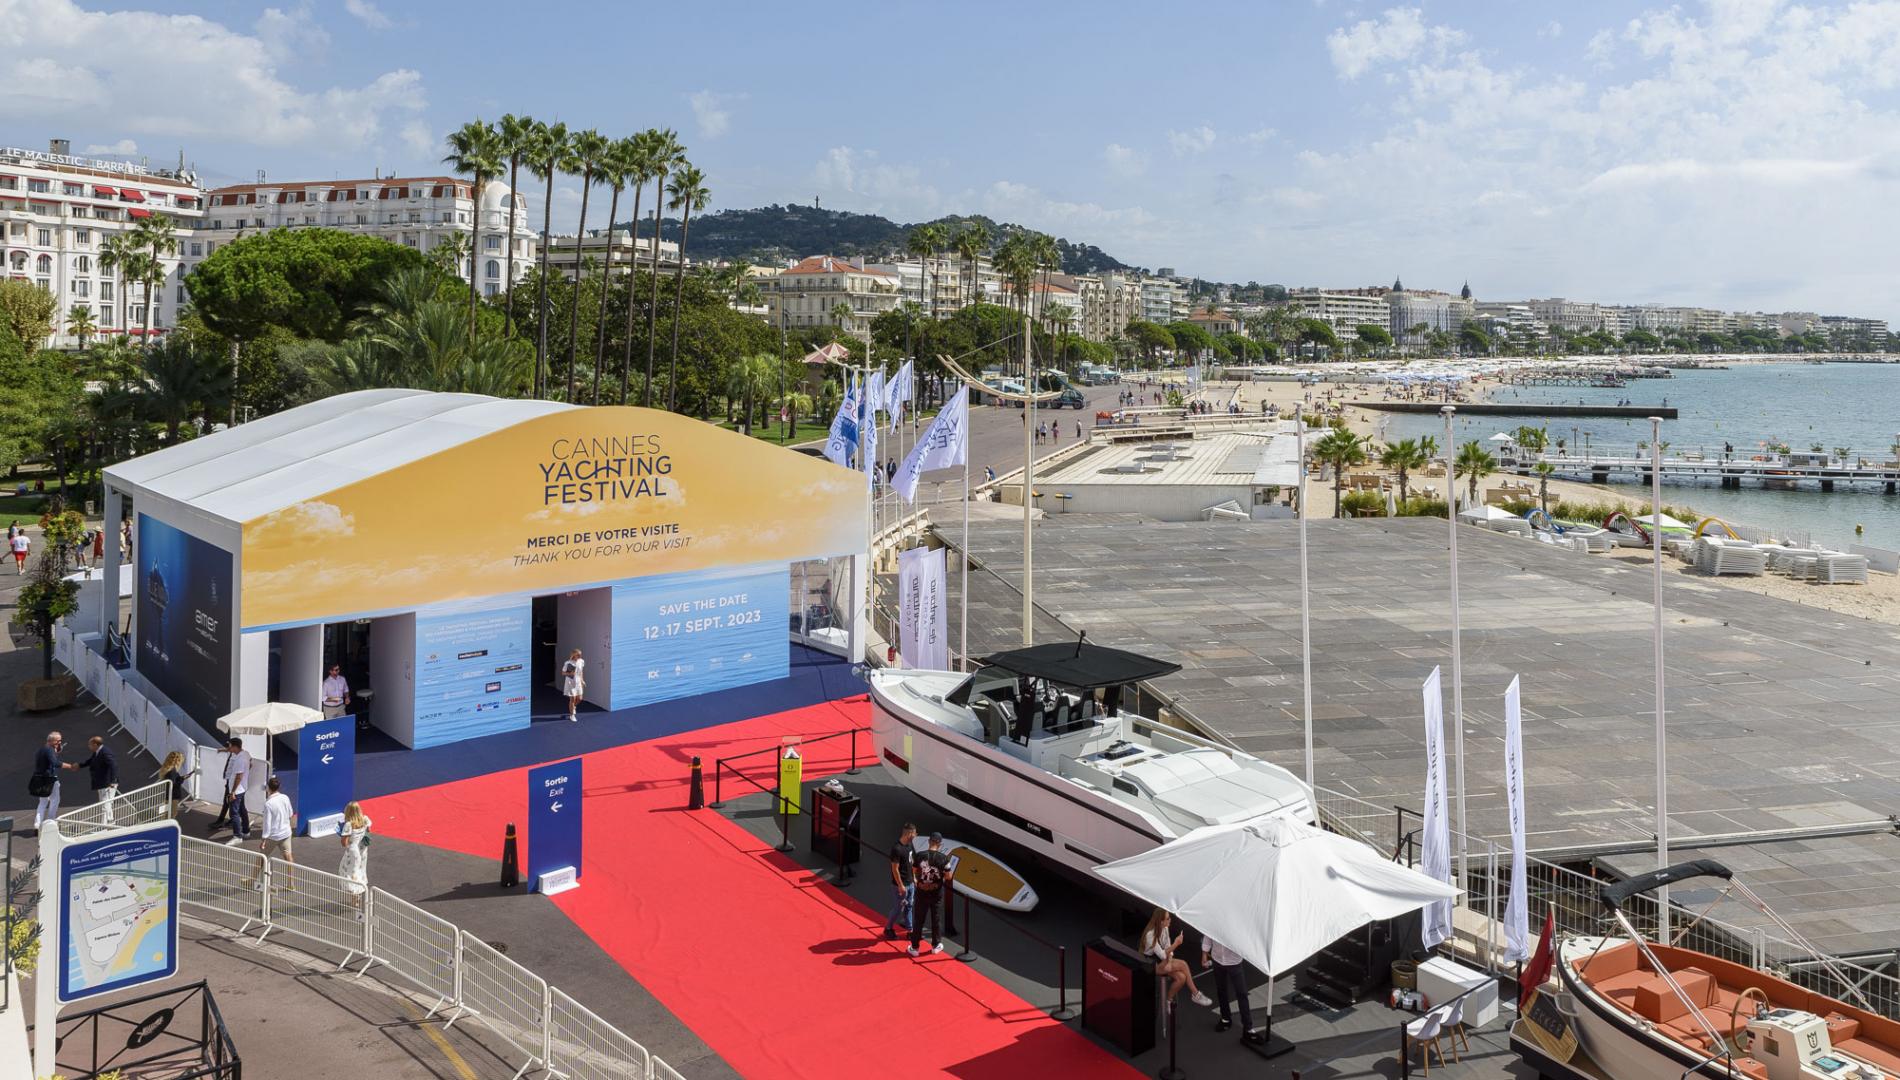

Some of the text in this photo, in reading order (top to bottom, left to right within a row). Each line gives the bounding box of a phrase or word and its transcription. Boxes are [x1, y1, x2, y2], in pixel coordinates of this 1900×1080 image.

[6, 147, 21, 158] LE
[25, 150, 83, 166] MAJESTIC
[552, 434, 661, 460] CANNES
[539, 455, 672, 483] YACHTING
[544, 477, 667, 506] FESTIVAL
[527, 523, 679, 549] MERCI DE VOTRE VISITE
[513, 536, 692, 567] THANK YOU FOR YOUR VISIT
[659, 593, 748, 616] SAVE THE DATE
[195, 608, 218, 632] amer
[685, 616, 723, 634] SEPT.
[727, 610, 761, 627] 2023
[315, 730, 340, 742] Sortie
[320, 741, 336, 751] Exit
[544, 775, 568, 788] Sortie
[549, 787, 564, 797] Exit
